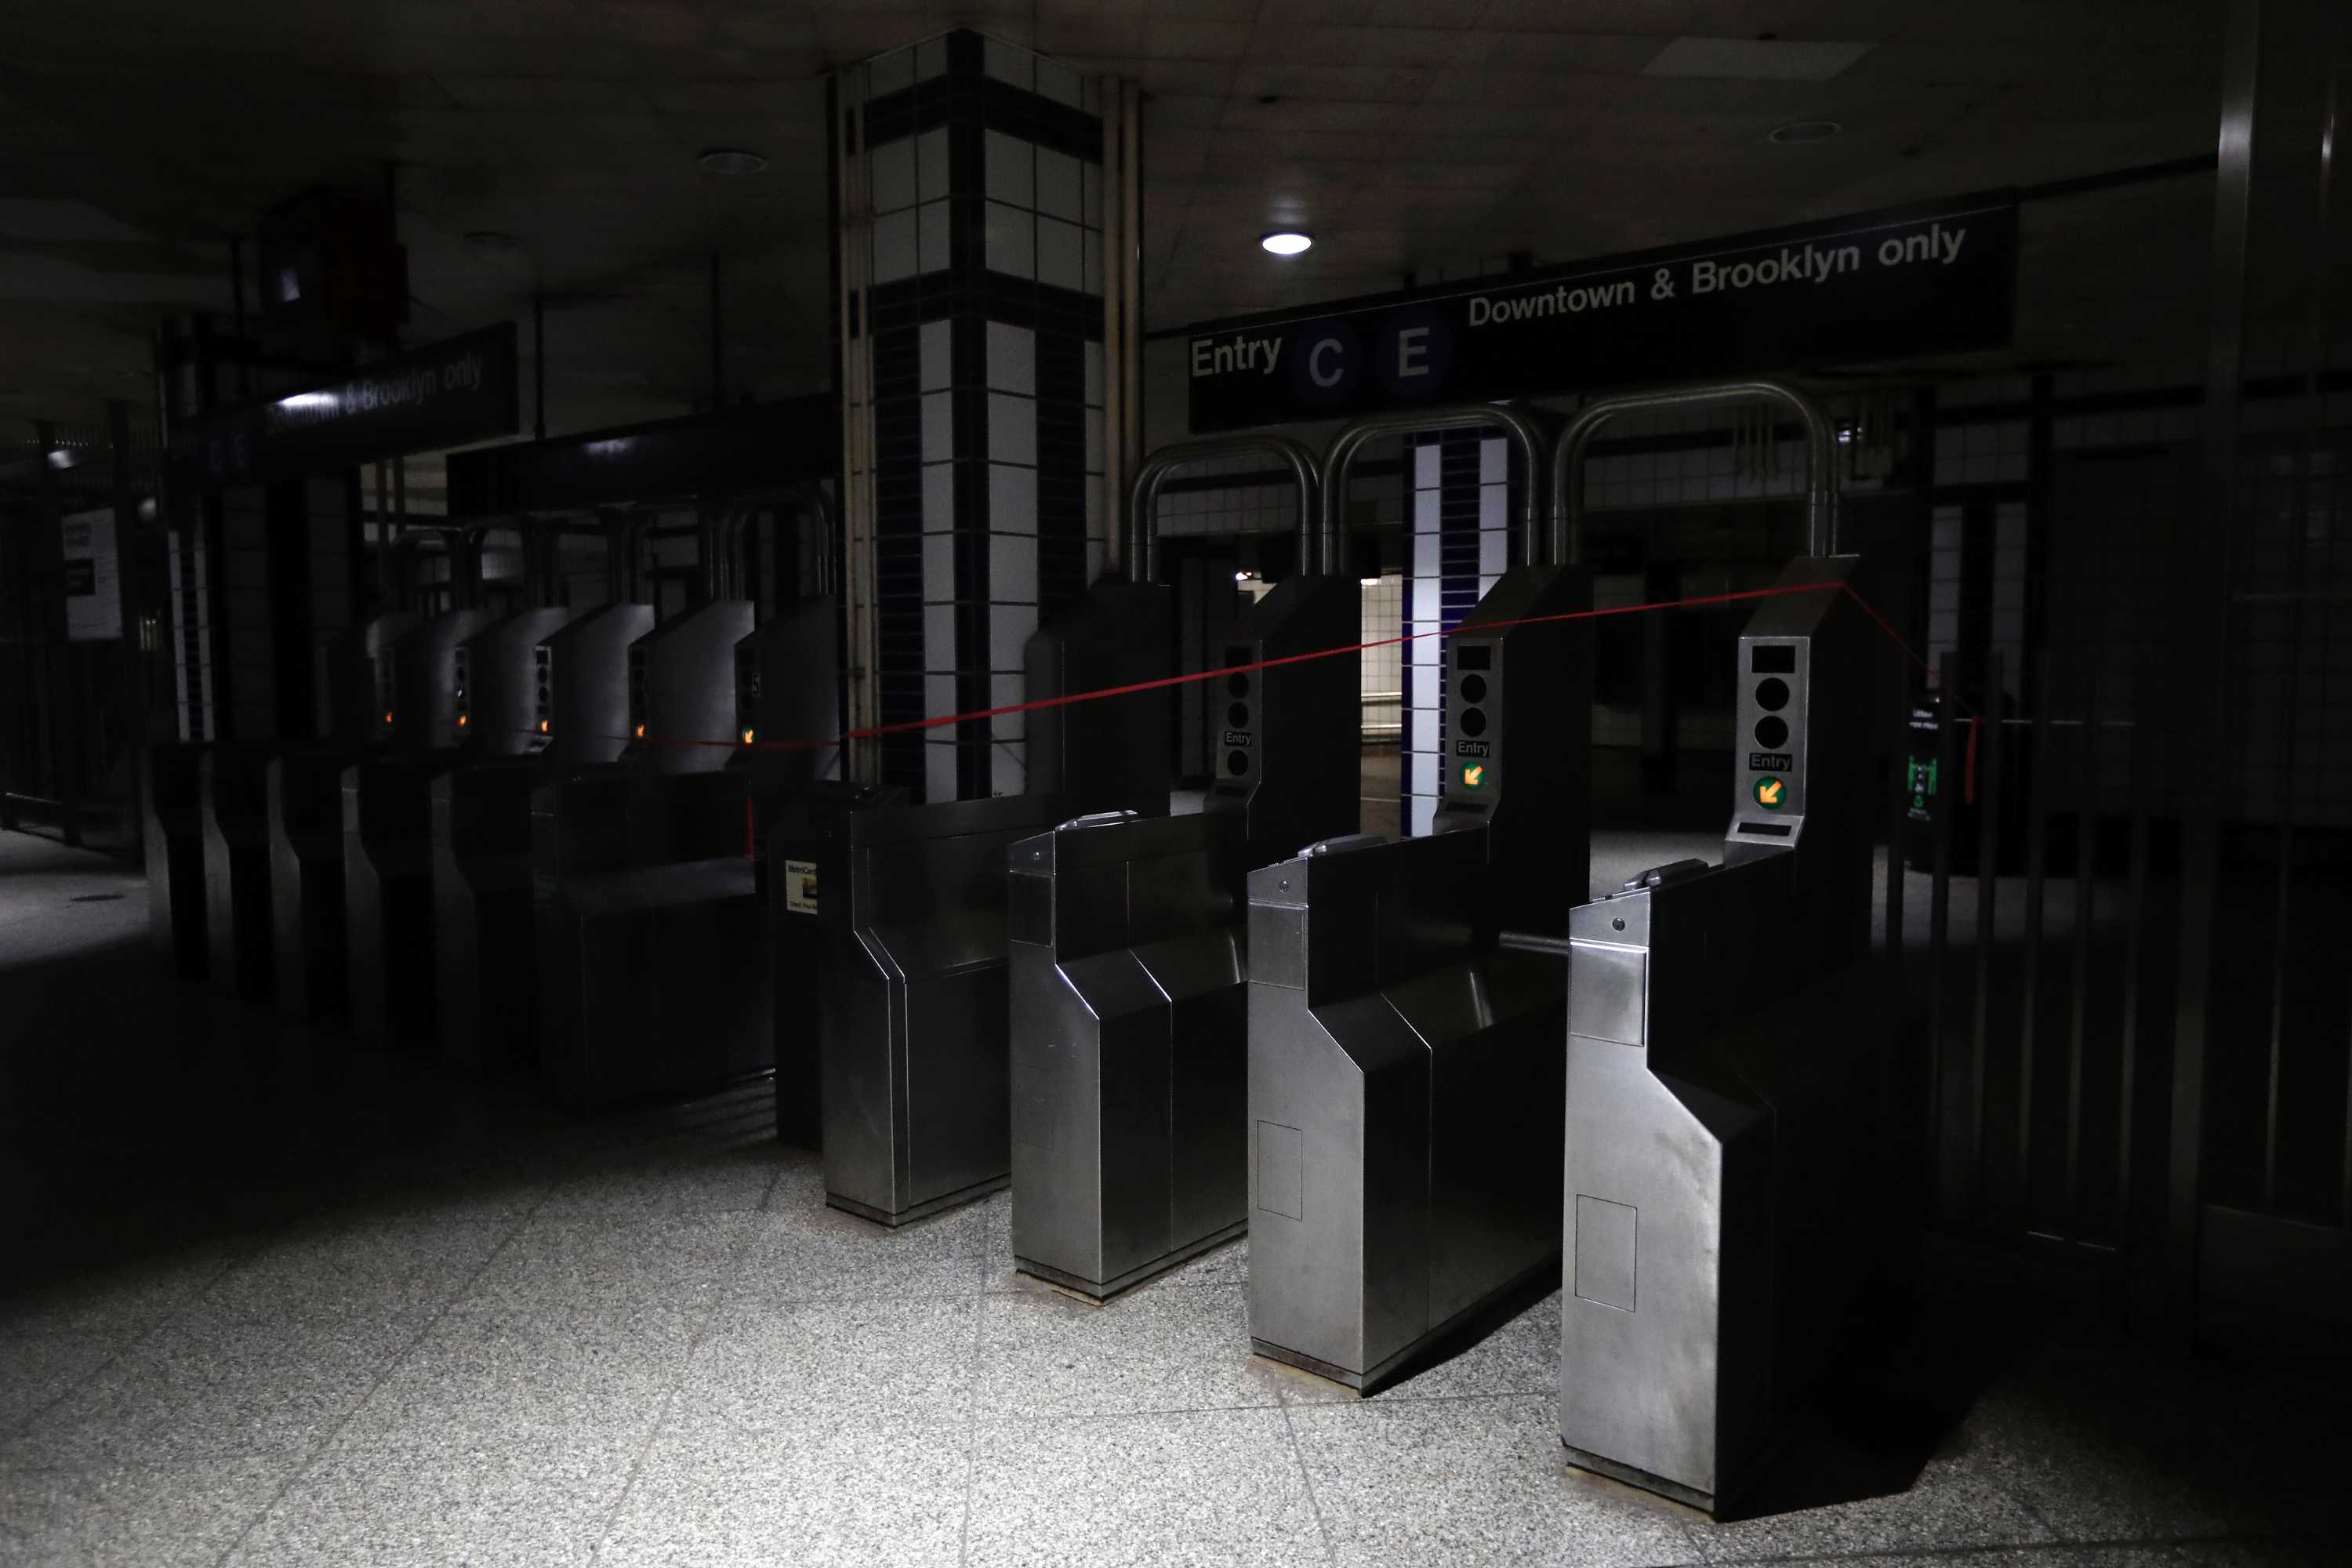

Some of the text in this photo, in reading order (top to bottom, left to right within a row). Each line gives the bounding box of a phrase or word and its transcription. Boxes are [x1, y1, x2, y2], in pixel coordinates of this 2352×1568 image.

[1192, 223, 1966, 387] Entry C E Downtown & Brooklyn only
[362, 363, 437, 409] Brooklyn
[444, 350, 483, 390] only
[1225, 732, 1251, 747] Entry
[1457, 742, 1490, 757] Entry
[1751, 754, 1791, 771] Entry
